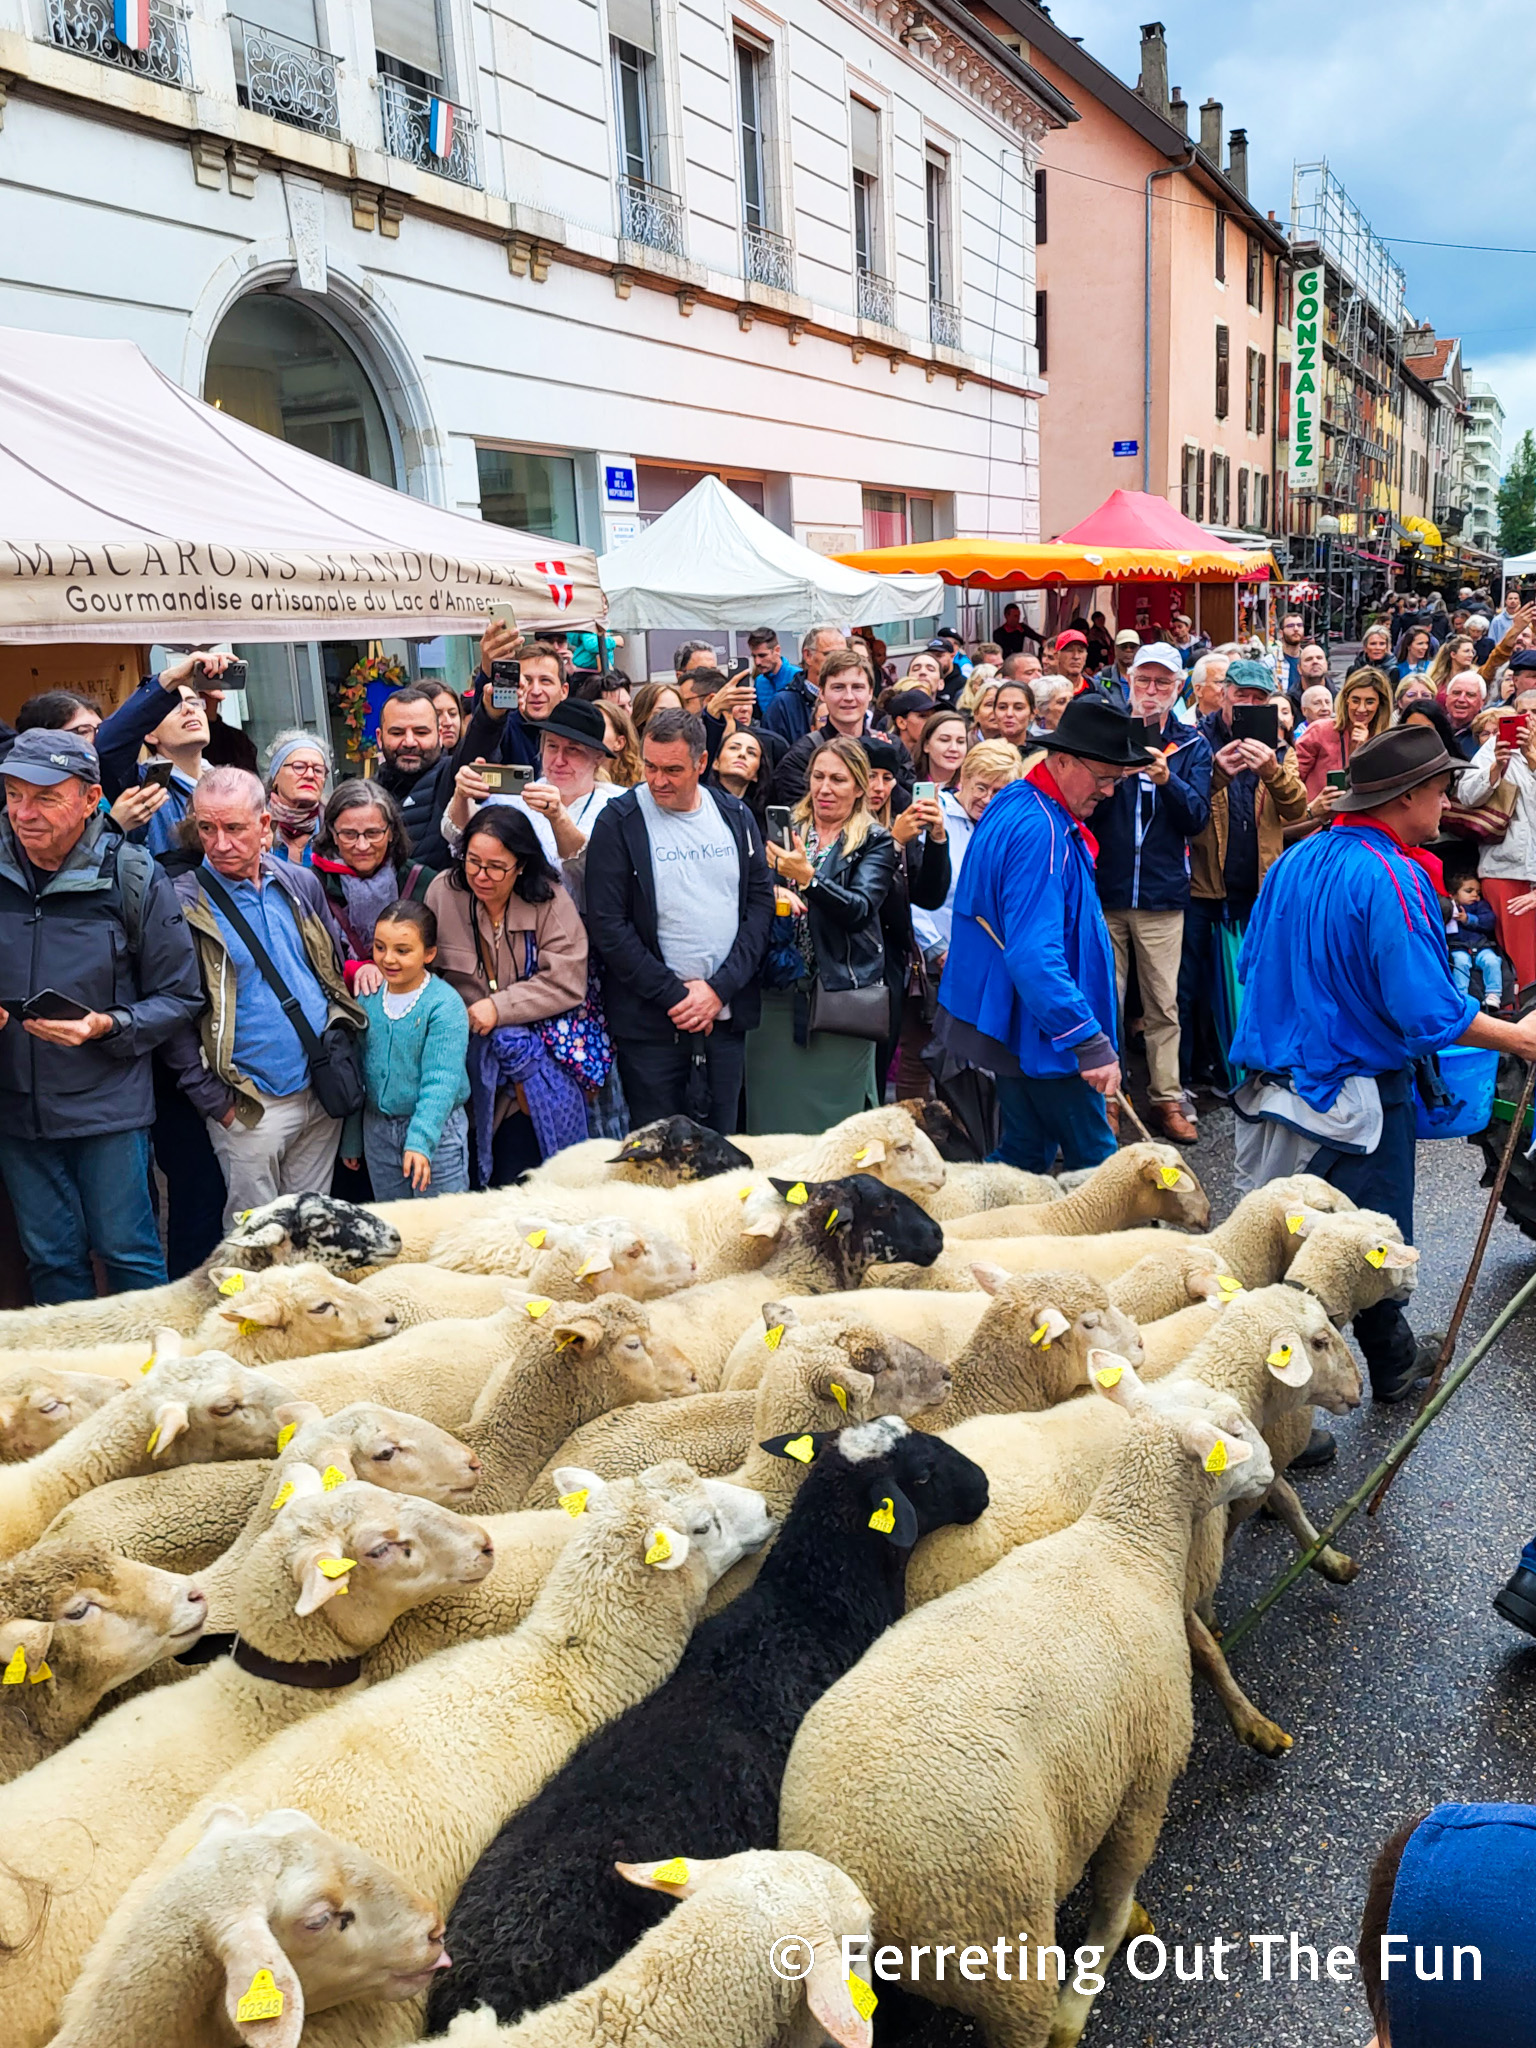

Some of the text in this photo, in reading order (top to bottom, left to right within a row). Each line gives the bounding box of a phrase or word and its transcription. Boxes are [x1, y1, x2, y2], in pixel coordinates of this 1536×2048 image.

[1295, 271, 1318, 467] GONZALEZ
[2, 539, 525, 588] MACARONS MANDOLIER
[65, 584, 243, 613] Gourmandise
[251, 586, 358, 612] artisanale
[363, 589, 387, 612] du
[391, 588, 424, 612] Lac
[656, 844, 735, 862] Calvin Klein
